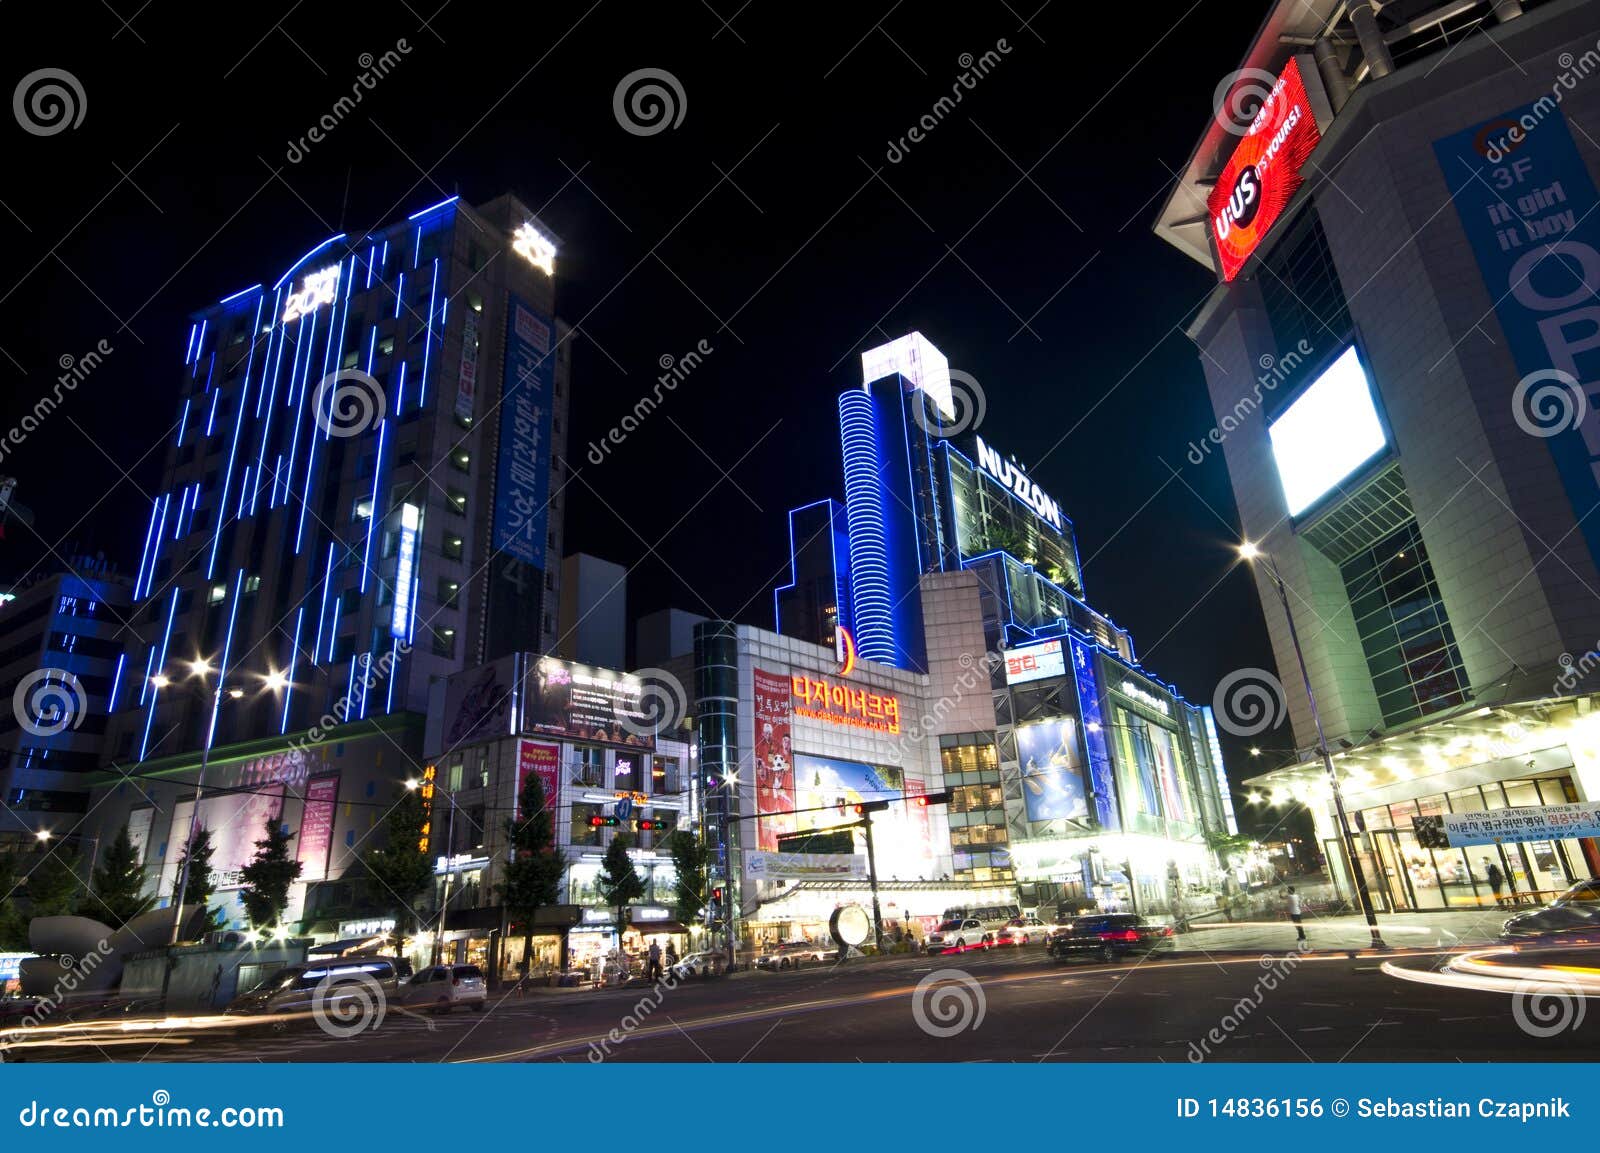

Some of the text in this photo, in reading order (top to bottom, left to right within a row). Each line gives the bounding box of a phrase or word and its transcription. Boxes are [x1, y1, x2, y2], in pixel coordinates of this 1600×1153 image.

[1265, 104, 1302, 160] YOURS!
[1491, 157, 1535, 190] 3F
[1216, 170, 1257, 240] U:US
[1486, 181, 1569, 226] it girl
[1496, 210, 1577, 252] it boy
[976, 435, 1062, 530] NUZZON
[791, 675, 900, 735] 디자이너크럽
[795, 706, 887, 732] www.designerclub.co.kr
